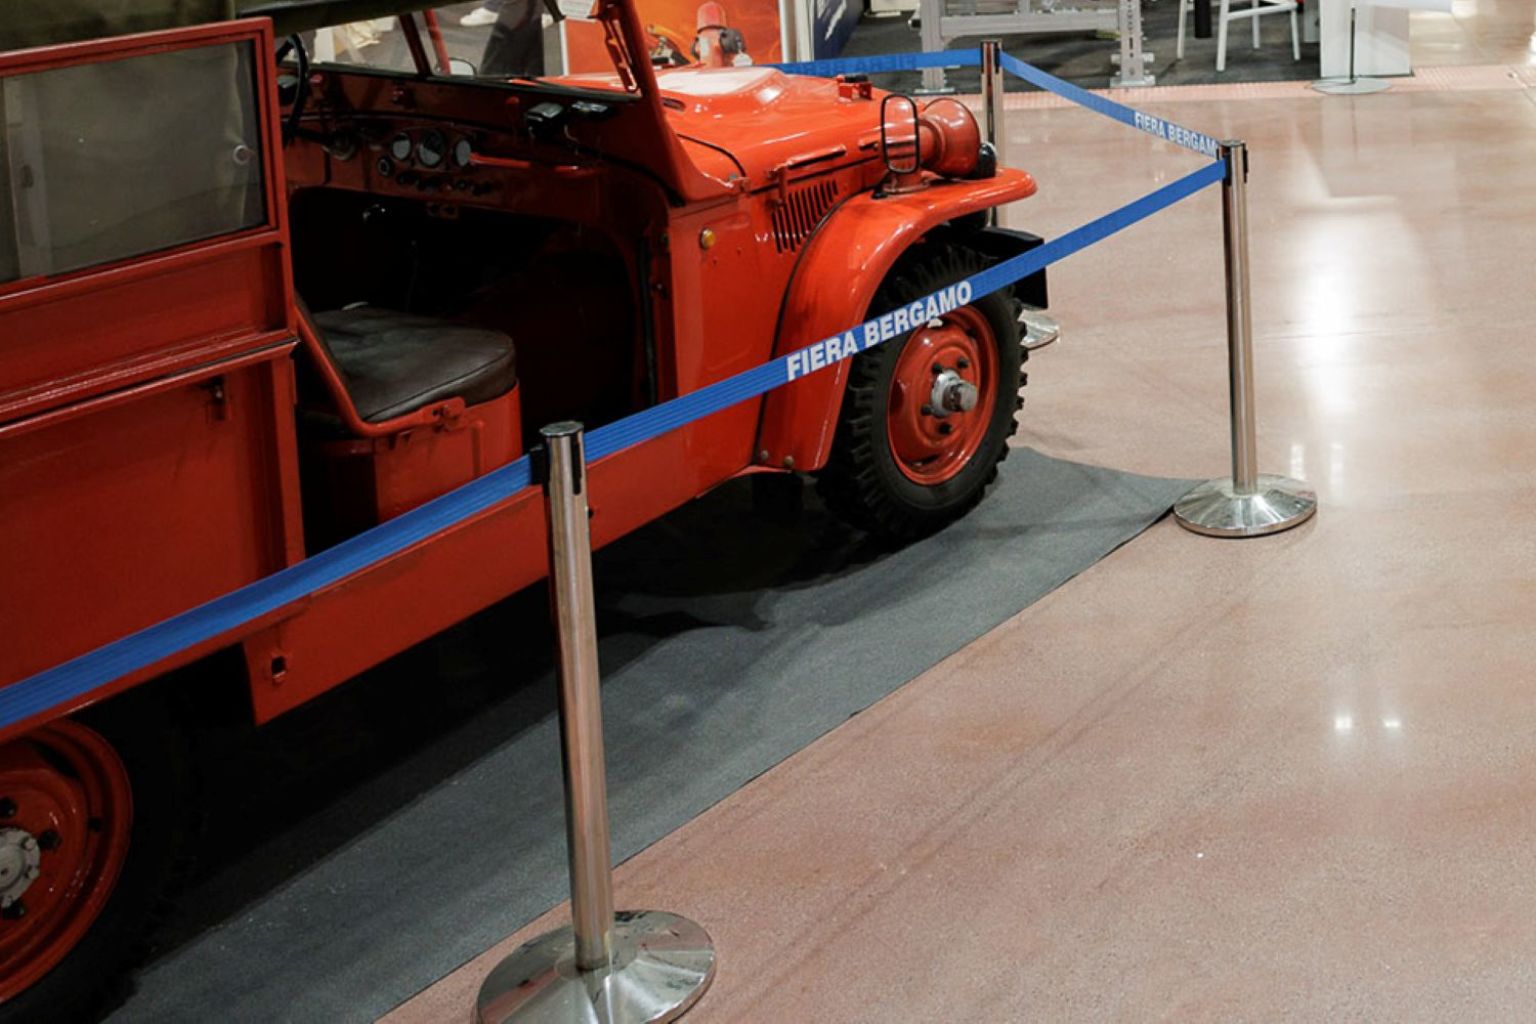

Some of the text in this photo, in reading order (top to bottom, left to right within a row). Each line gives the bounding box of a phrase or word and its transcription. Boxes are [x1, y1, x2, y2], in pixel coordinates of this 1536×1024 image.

[1134, 111, 1217, 158] FIERA BERGAM
[786, 280, 972, 382] FIERA BERGAMO
